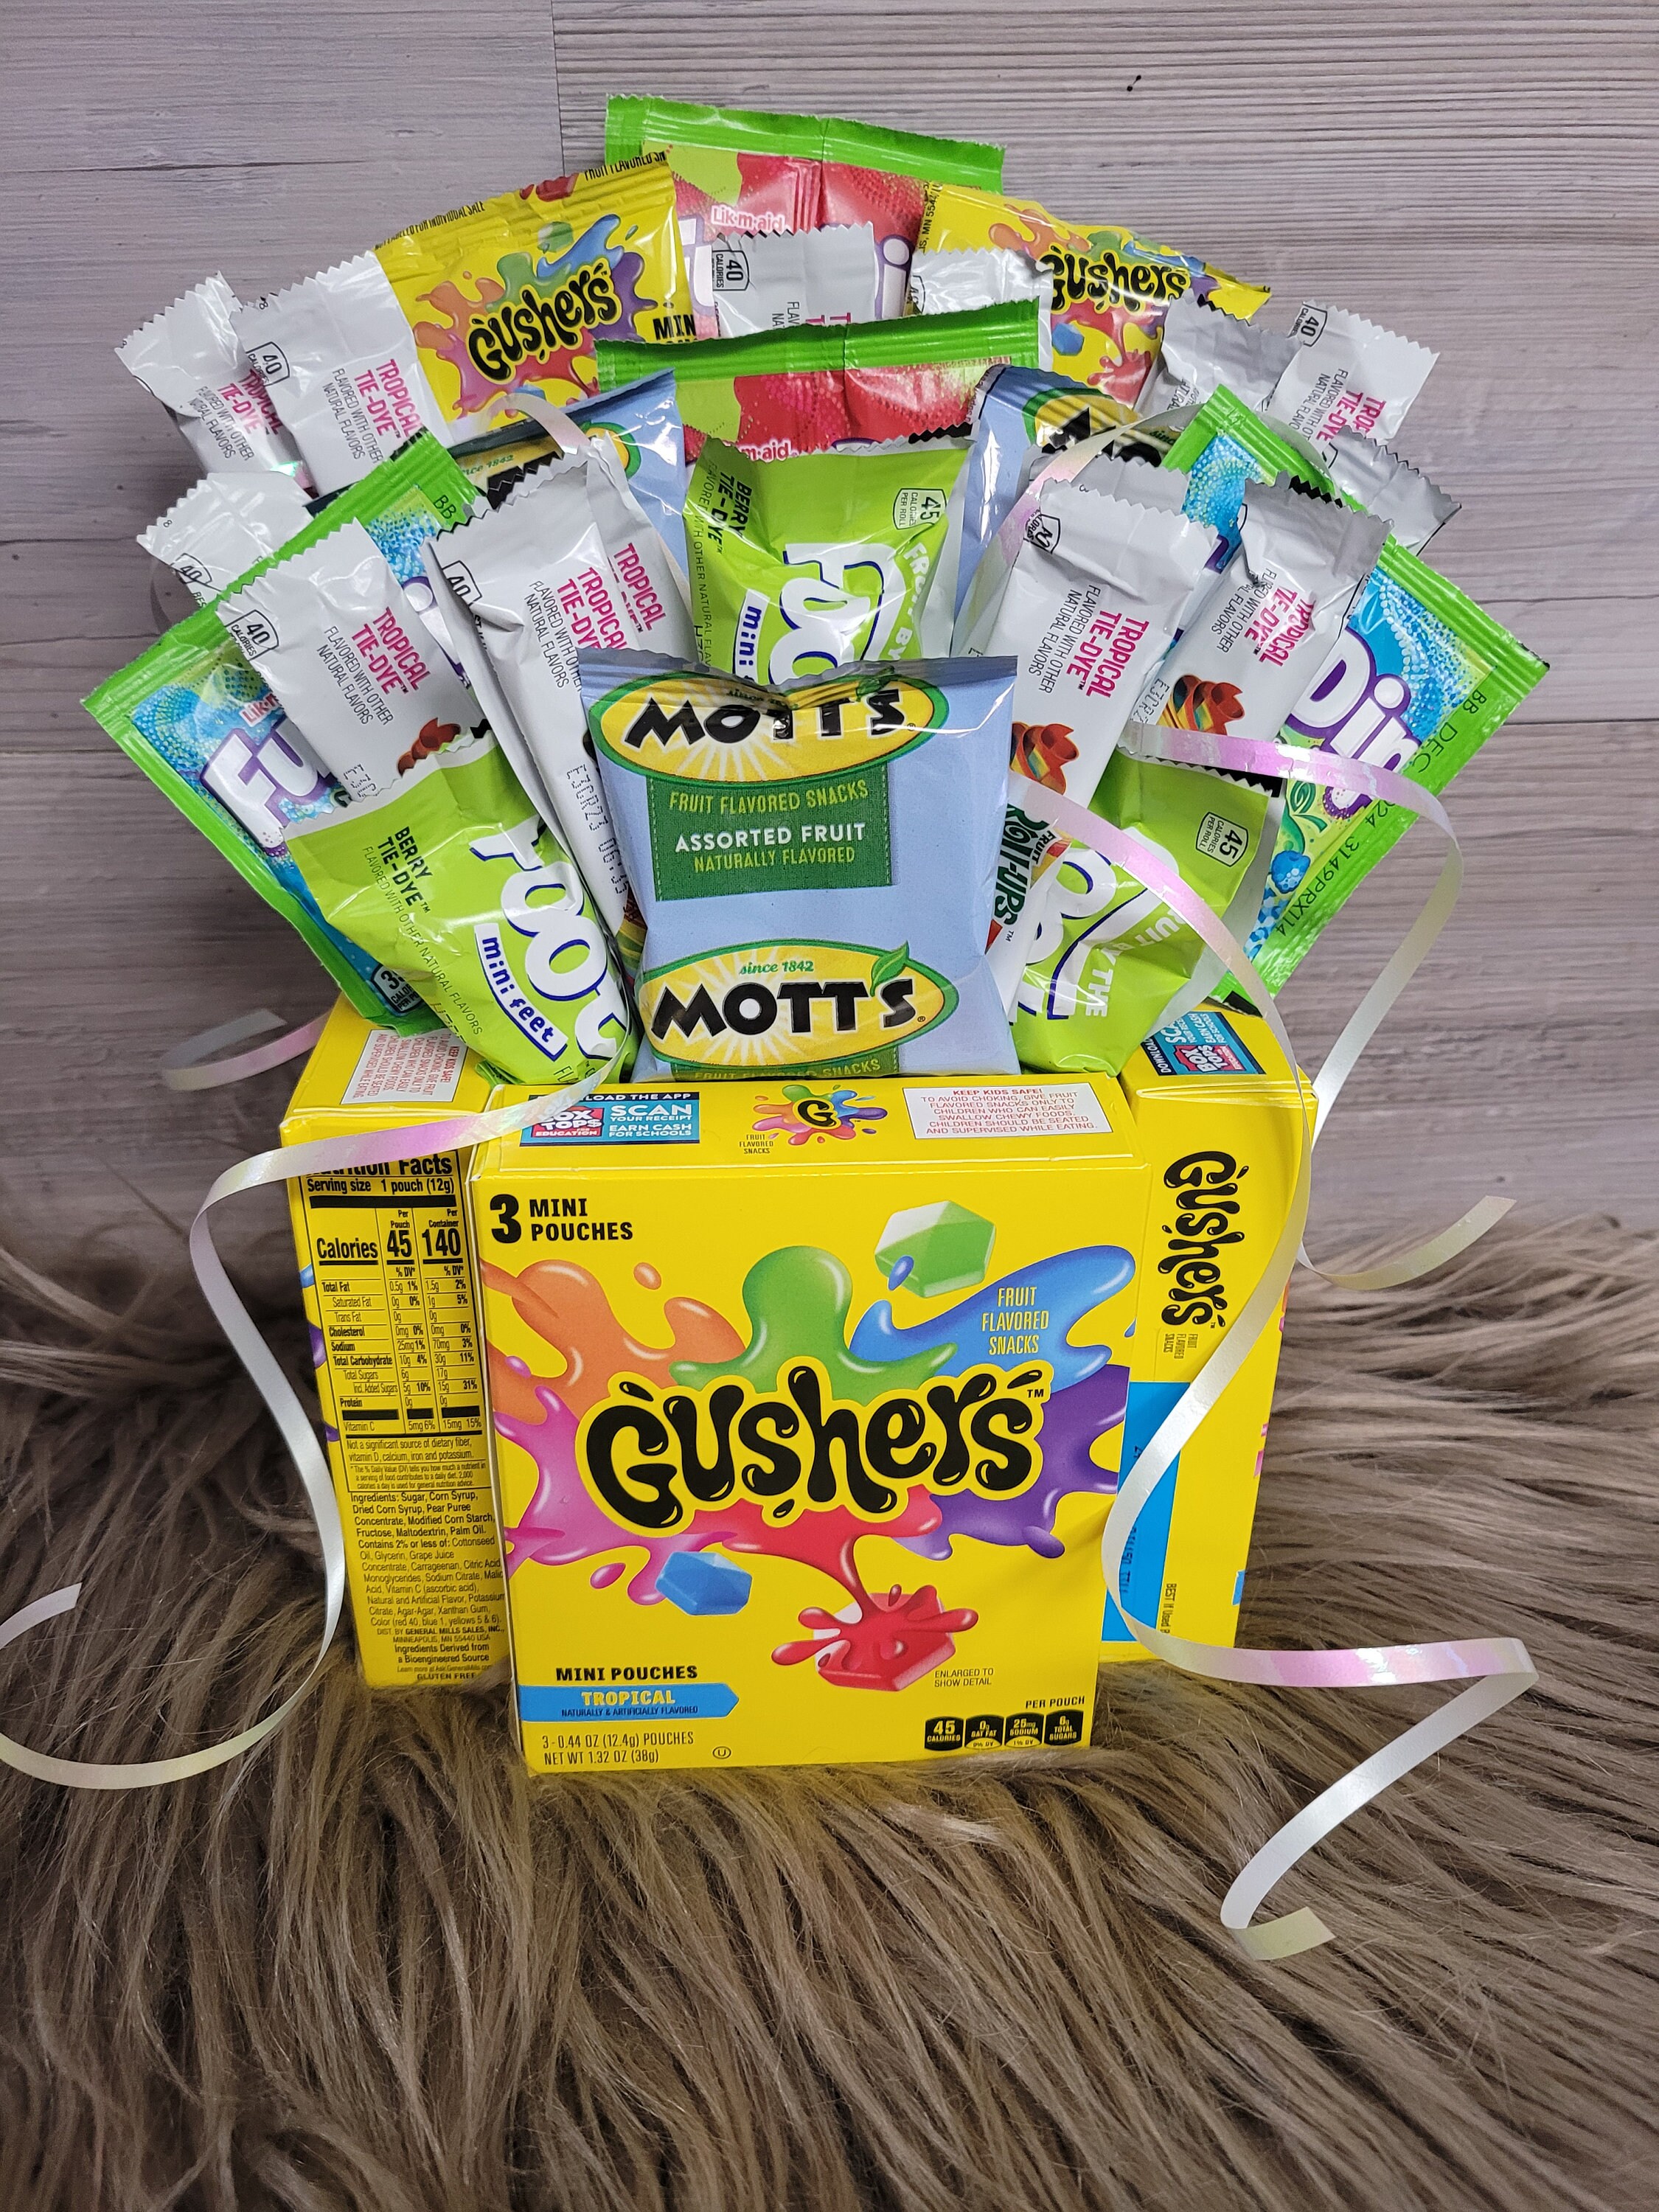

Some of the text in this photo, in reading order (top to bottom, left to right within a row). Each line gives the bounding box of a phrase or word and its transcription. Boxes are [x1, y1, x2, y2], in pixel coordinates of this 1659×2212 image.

[716, 254, 724, 288] CALORIES
[726, 259, 743, 281] 40
[1301, 316, 1318, 336] 40
[262, 354, 282, 374] 40
[377, 359, 422, 437] TROPICAL
[1303, 373, 1330, 405] NATURAL
[1315, 369, 1348, 425] FLAVORED WITH
[323, 383, 365, 459] NATURAL FLAVORS
[333, 369, 383, 463] FLAVORED WITH OTHER
[487, 454, 514, 468] 1842
[434, 495, 457, 520] BB
[733, 481, 752, 537] BERRY
[909, 492, 918, 526] CALORIES
[920, 496, 941, 520] 45
[614, 543, 666, 630] TROPICAL
[694, 543, 712, 634] OTHER NATURAL
[529, 581, 574, 657] FLAVORED WITH
[1211, 594, 1243, 634] FLAVORS
[1217, 597, 1259, 653] WITH OTHER
[232, 625, 257, 656] CALORIES
[246, 624, 270, 644] 40
[524, 594, 569, 689] NATURAL FLAVORS
[739, 606, 762, 666] mini
[1029, 589, 1082, 676] NATURAL FLAVORS
[1039, 585, 1101, 693] FLAVORED WITH OTHER
[373, 606, 431, 690] TROPICAL
[1086, 618, 1150, 698] TROPICAL
[317, 644, 373, 725] NATURAL FLAVORS
[324, 626, 394, 726] FLAVORED WITH OTHER
[1414, 689, 1486, 774] BB DEC
[669, 780, 869, 814] FRUIT FLAVORED SNACKS
[675, 823, 866, 852] ASSORTED FRUIT
[1034, 830, 1057, 864] FRUIT
[1200, 832, 1211, 847] ROLL
[1208, 821, 1224, 853] CALORIES
[1220, 830, 1242, 860] 45
[395, 827, 432, 878] BERRY
[695, 847, 855, 873] NATURALLY FLAVORED
[363, 846, 389, 891] FLAVORED
[386, 891, 404, 914] WITH
[400, 914, 425, 947] OTHER
[420, 948, 453, 993] NATURAL
[450, 992, 482, 1034] FLAVORS
[739, 959, 814, 976] since 1842
[482, 937, 555, 1043] mini feet
[1086, 969, 1113, 1017] THE
[541, 1119, 602, 1130] TOPS
[611, 1105, 692, 1116] SCAN
[399, 1154, 453, 1175] Facts
[307, 1178, 454, 1194] Serving size 1 pouch (12g)
[391, 1209, 410, 1228] Per Pouch
[490, 1194, 587, 1243] 3 MINI
[531, 1222, 633, 1242] POUCHES
[317, 1229, 460, 1259] Calories 45 140
[998, 1285, 1037, 1308] FRUIT
[981, 1310, 1049, 1332] FLAVORED
[989, 1334, 1040, 1356] SNACKS
[351, 1491, 478, 1504] Ingredients: Sugar, Corn Syrup,
[353, 1505, 374, 1514] Dried
[398, 1505, 424, 1515] Syrup,
[448, 1503, 470, 1512] Puree
[556, 1666, 698, 1681] MINI POUCHES
[935, 1668, 994, 1678] ENLARGED TO
[935, 1677, 992, 1688] SHOW DETAIL
[581, 1690, 675, 1705] TROPICAL
[1026, 1696, 1085, 1709] PER POUCH
[558, 1731, 694, 1748] 0.44 OZ (12.4g) POUCHES
[933, 1720, 956, 1734] 45
[544, 1749, 659, 1765] NET WT 1.32 OZ (38g)
